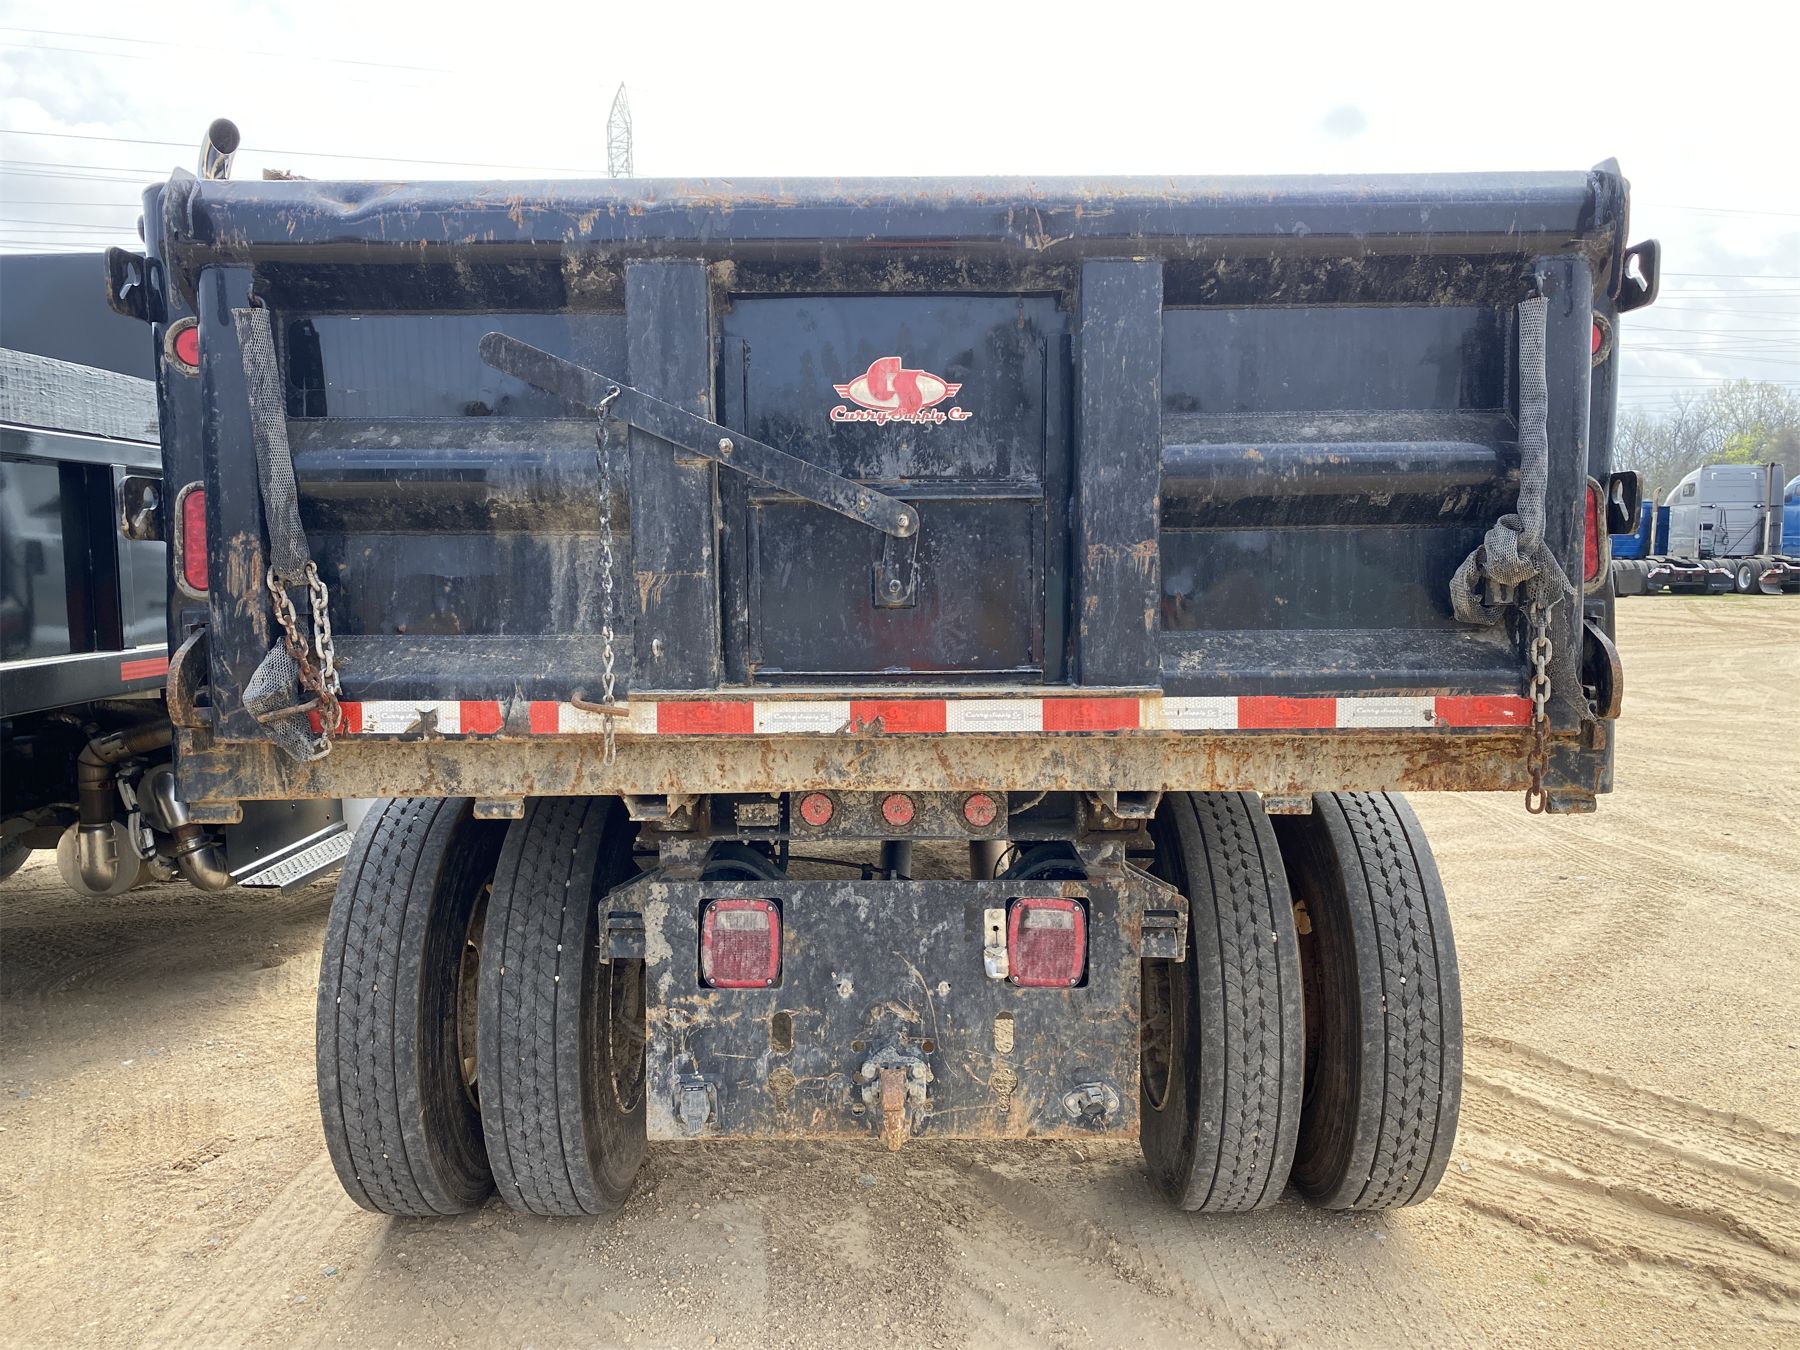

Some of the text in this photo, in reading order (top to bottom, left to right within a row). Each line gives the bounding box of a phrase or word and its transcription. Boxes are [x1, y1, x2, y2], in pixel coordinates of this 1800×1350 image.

[830, 405, 973, 425] Curry Supply Co
